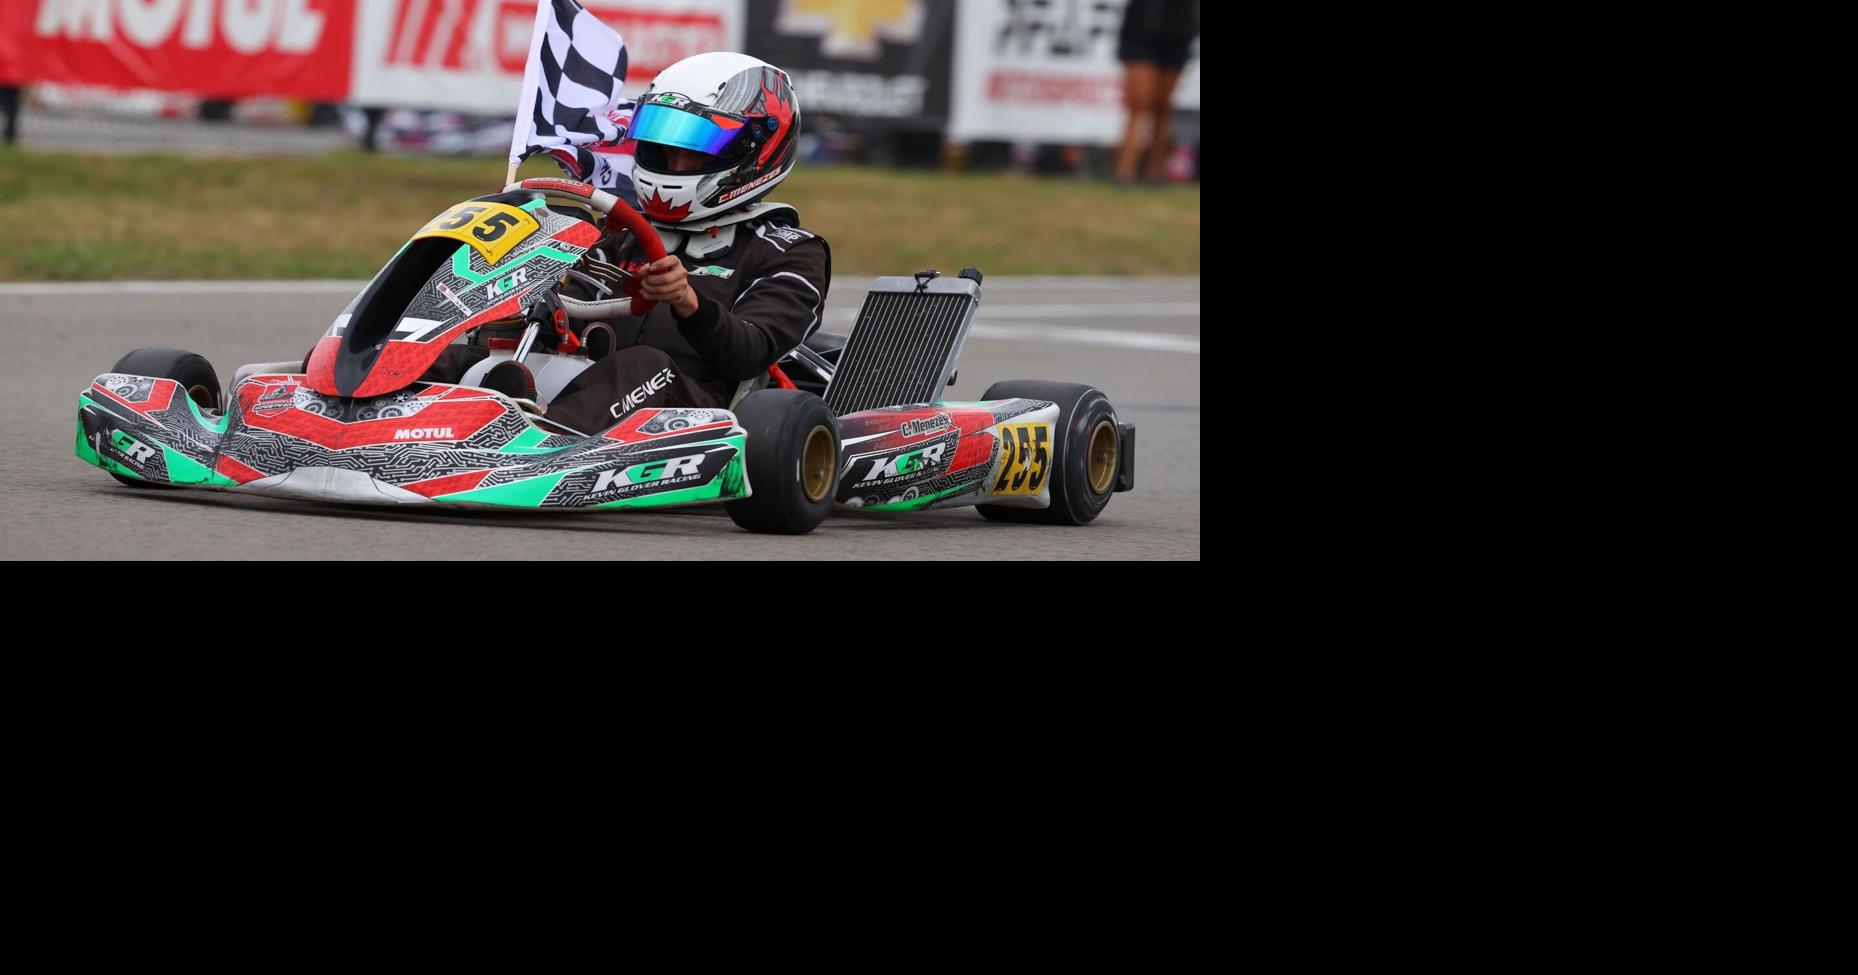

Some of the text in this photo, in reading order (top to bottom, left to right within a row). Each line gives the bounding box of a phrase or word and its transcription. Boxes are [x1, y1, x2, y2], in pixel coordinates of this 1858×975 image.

[34, 0, 327, 54] MOTUL
[420, 206, 520, 242] 55
[486, 267, 527, 300] KGR
[394, 427, 455, 440] MOTUL
[590, 453, 706, 493] KGR
[862, 442, 946, 481] KGR
[993, 426, 1048, 491] 255
[583, 474, 702, 501] KEVIN GLOVER RACING
